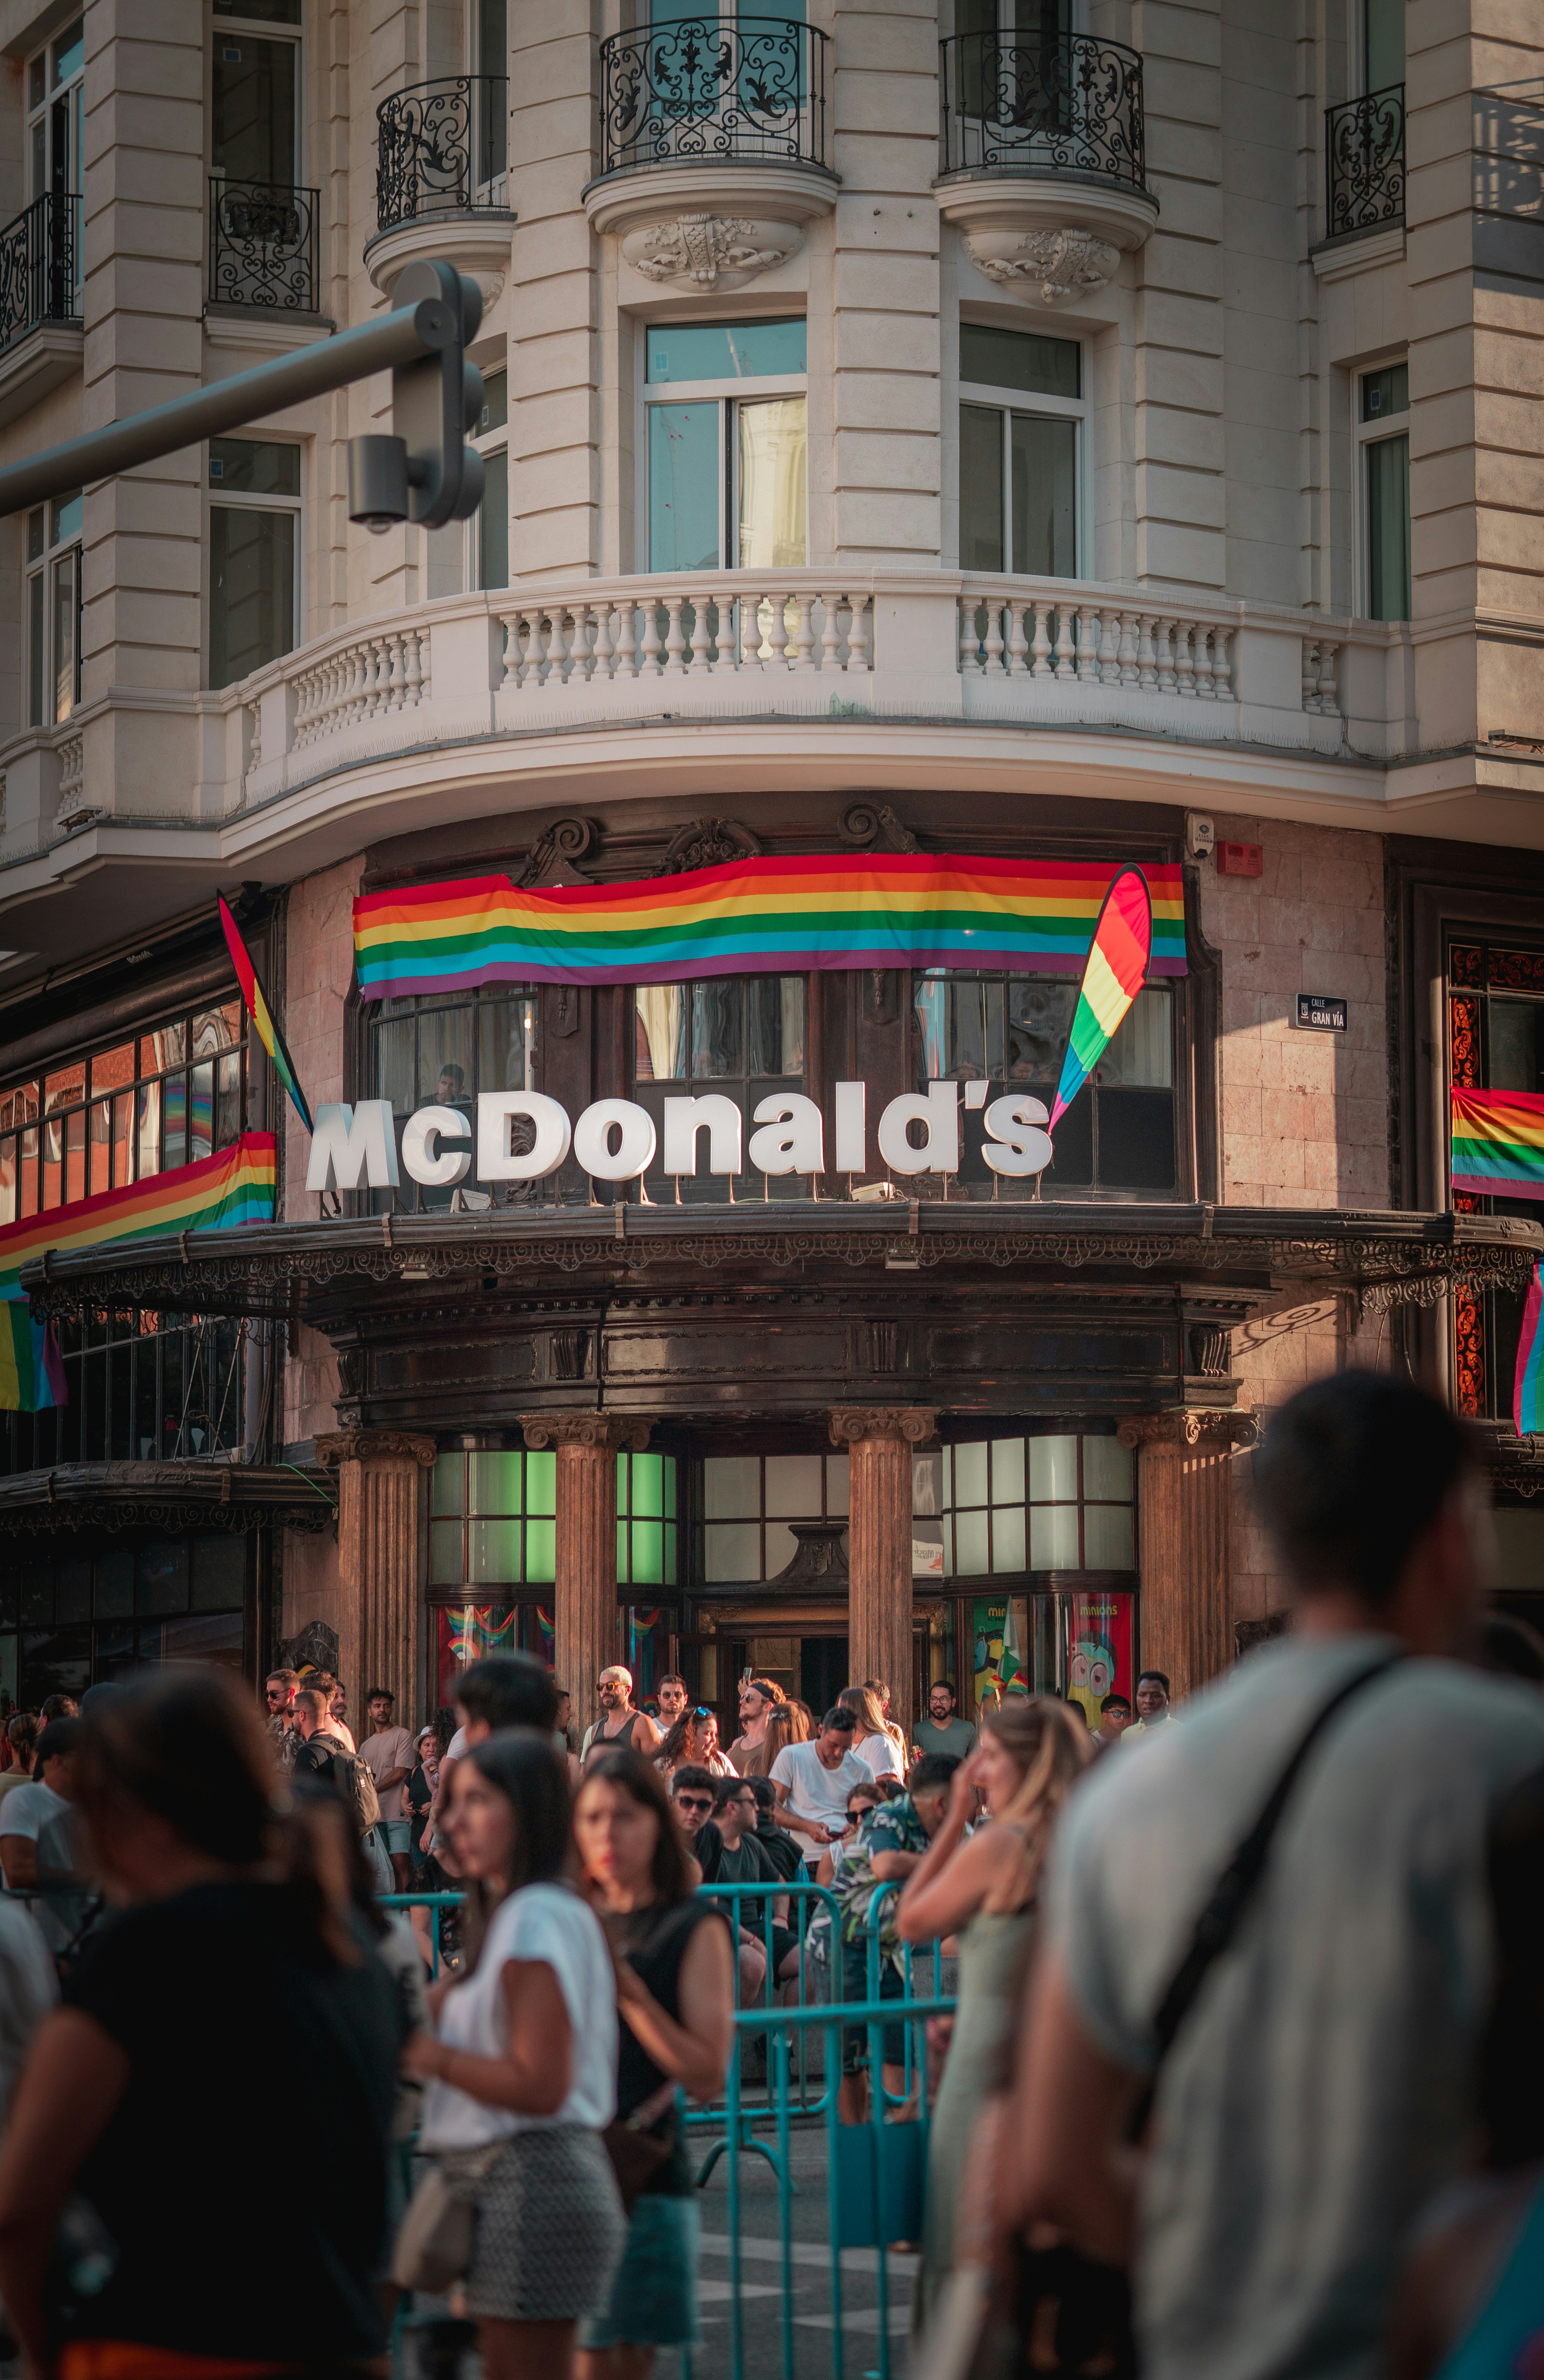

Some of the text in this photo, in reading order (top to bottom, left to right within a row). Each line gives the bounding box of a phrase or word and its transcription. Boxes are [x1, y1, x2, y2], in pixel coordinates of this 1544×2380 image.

[1312, 998, 1325, 1008] CALLE
[1312, 1011, 1344, 1026] GRAN VÍA
[306, 1080, 1053, 1192] McDonald's
